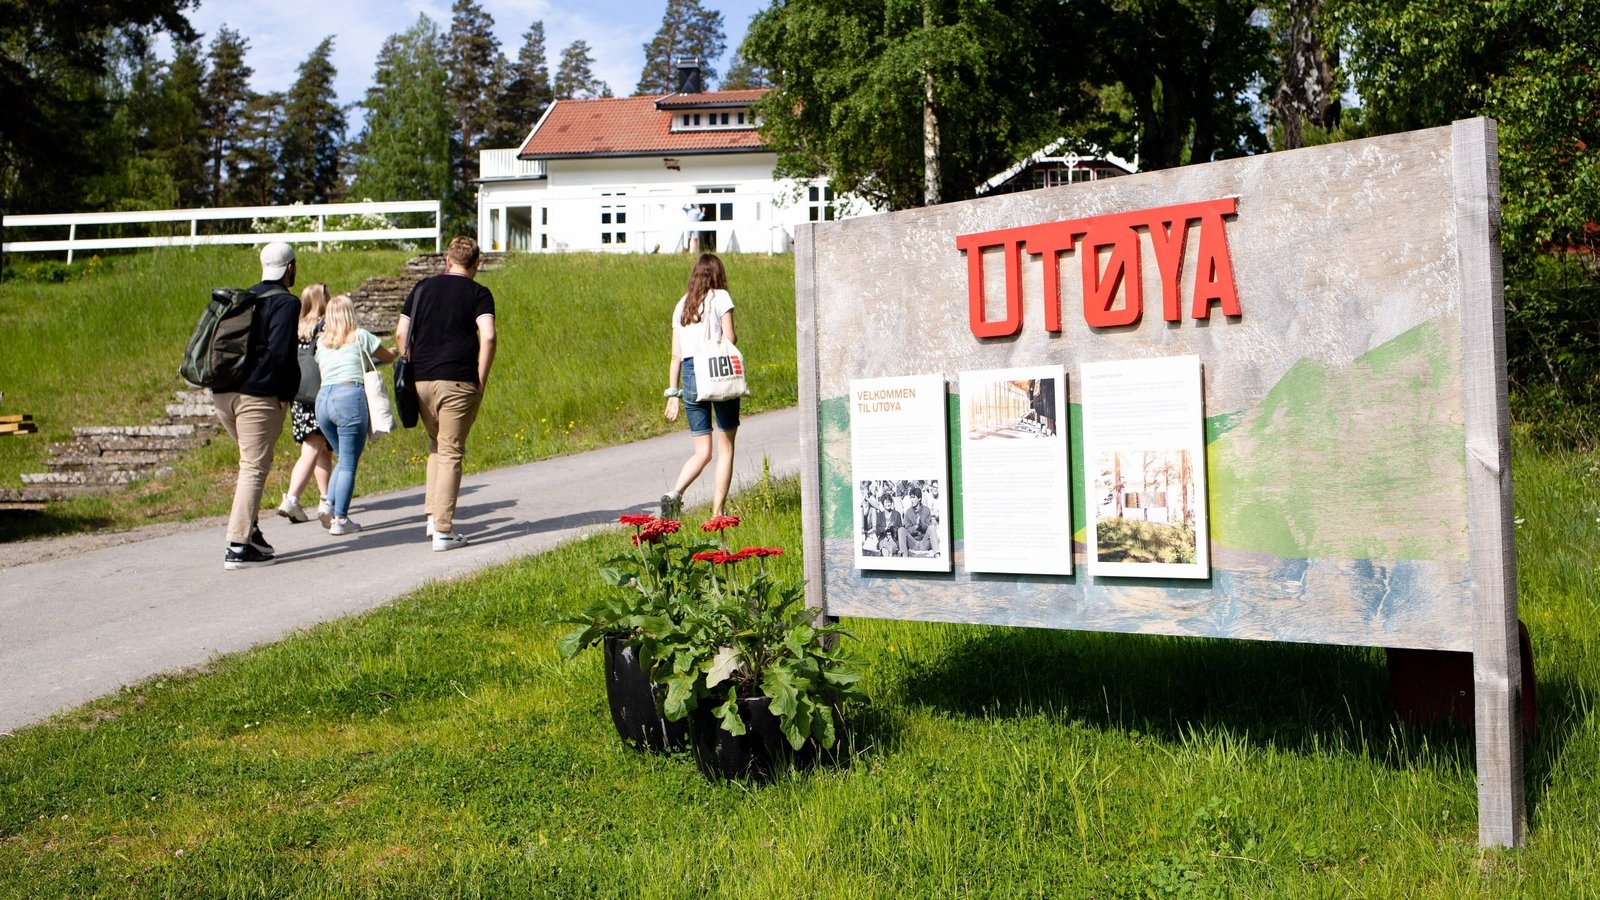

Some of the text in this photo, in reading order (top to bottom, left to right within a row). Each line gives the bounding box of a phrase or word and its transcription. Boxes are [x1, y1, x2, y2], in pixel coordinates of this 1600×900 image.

[956, 197, 1242, 338] UTØYA
[857, 388, 916, 400] VELKOMMEN
[857, 401, 902, 413] TIL UTØYA
